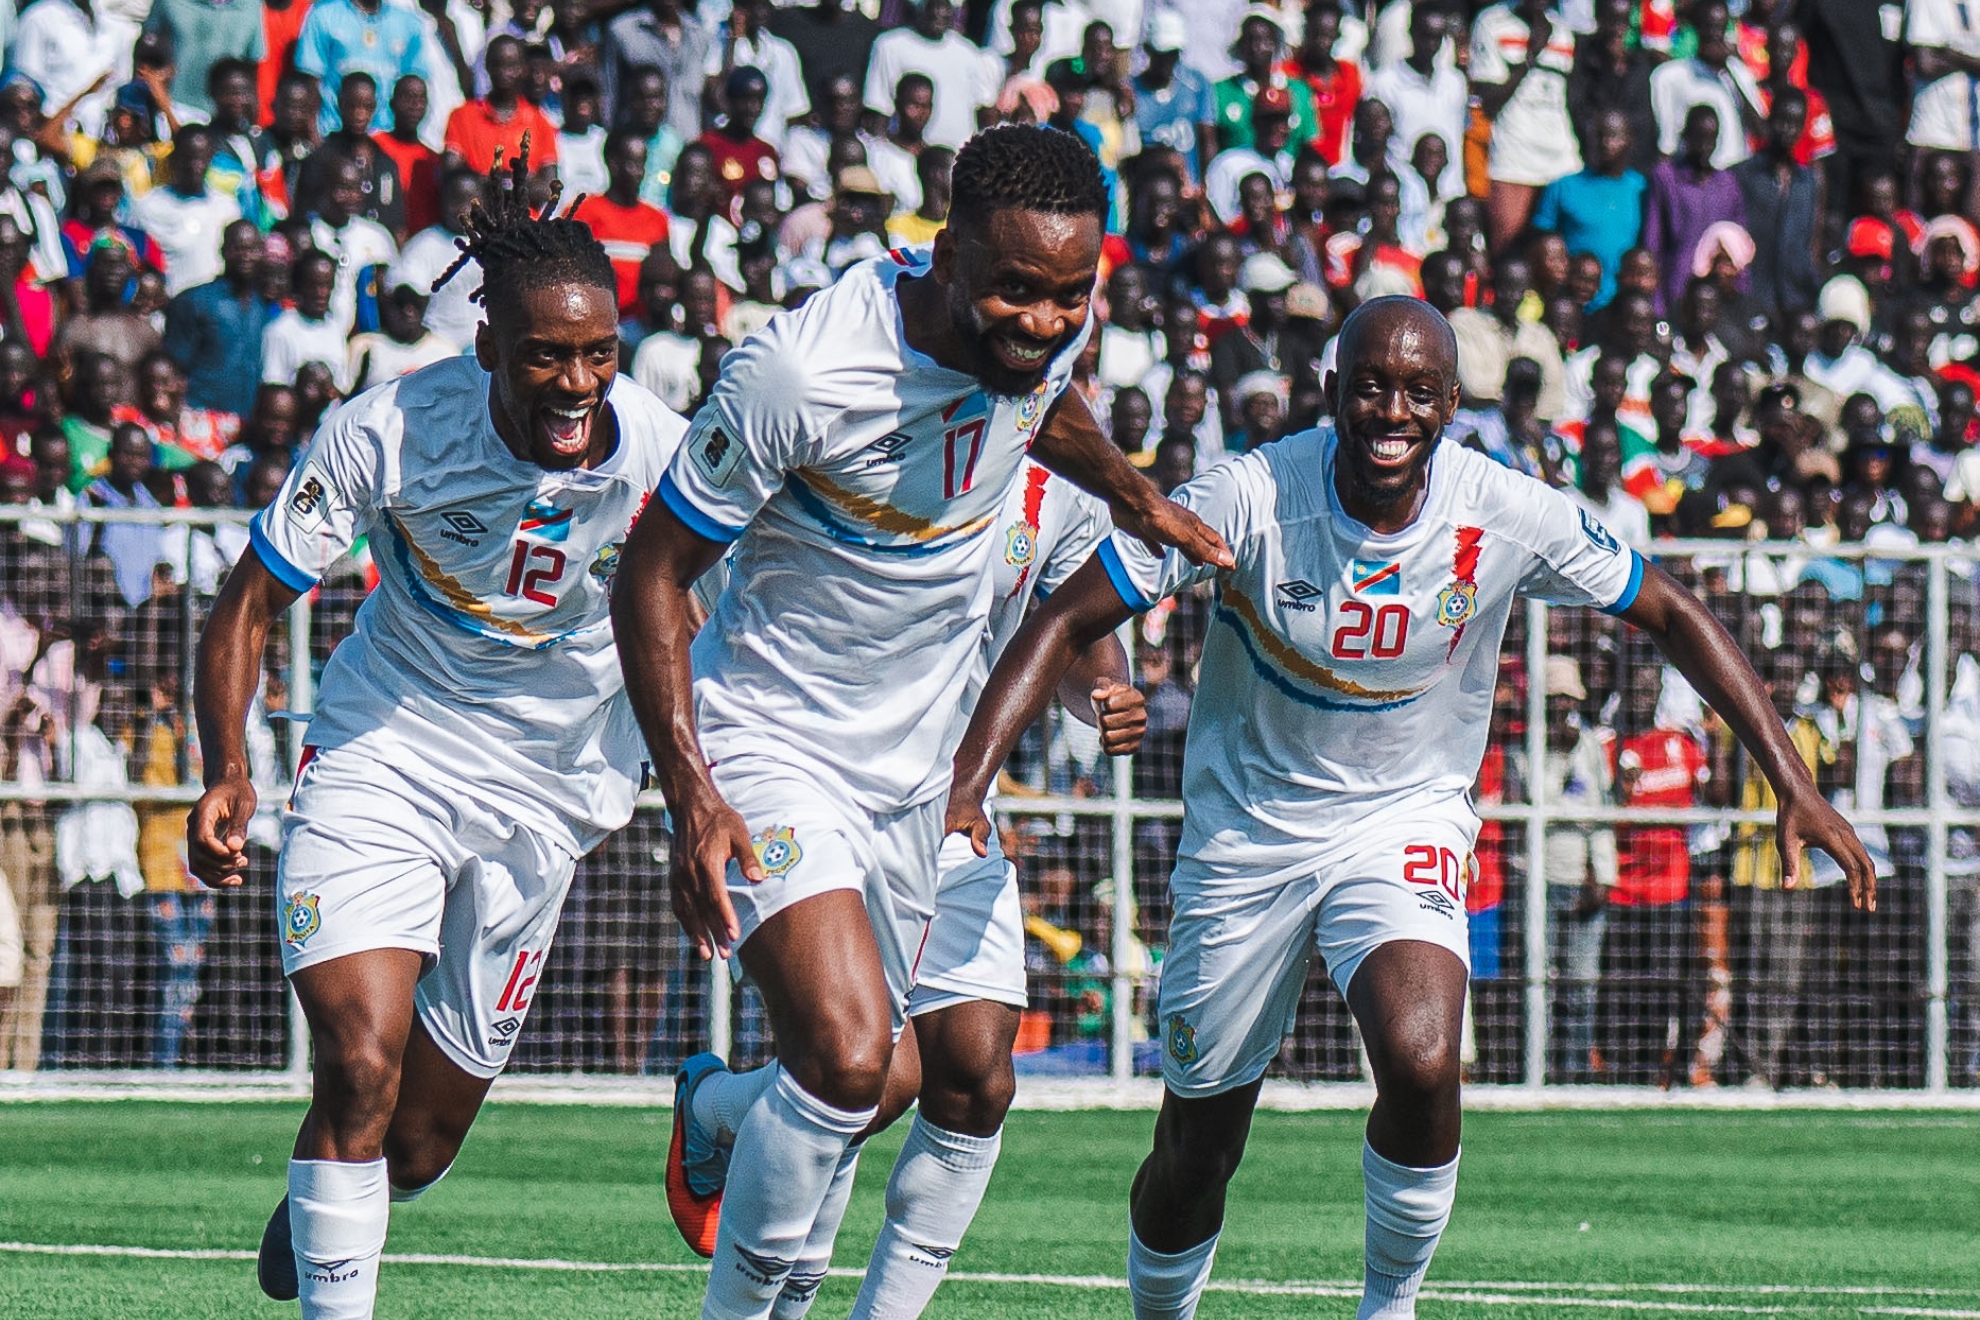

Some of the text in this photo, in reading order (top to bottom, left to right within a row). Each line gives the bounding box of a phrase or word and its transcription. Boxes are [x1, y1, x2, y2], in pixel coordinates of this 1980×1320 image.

[866, 452, 906, 467] umbro
[943, 418, 987, 500] 17
[440, 528, 480, 548] umbro
[505, 540, 567, 607] 12
[1277, 598, 1316, 613] umbro
[1332, 601, 1410, 660] 20
[1403, 845, 1460, 901] 20
[496, 950, 543, 1011] 12
[304, 1268, 359, 1283] umbro
